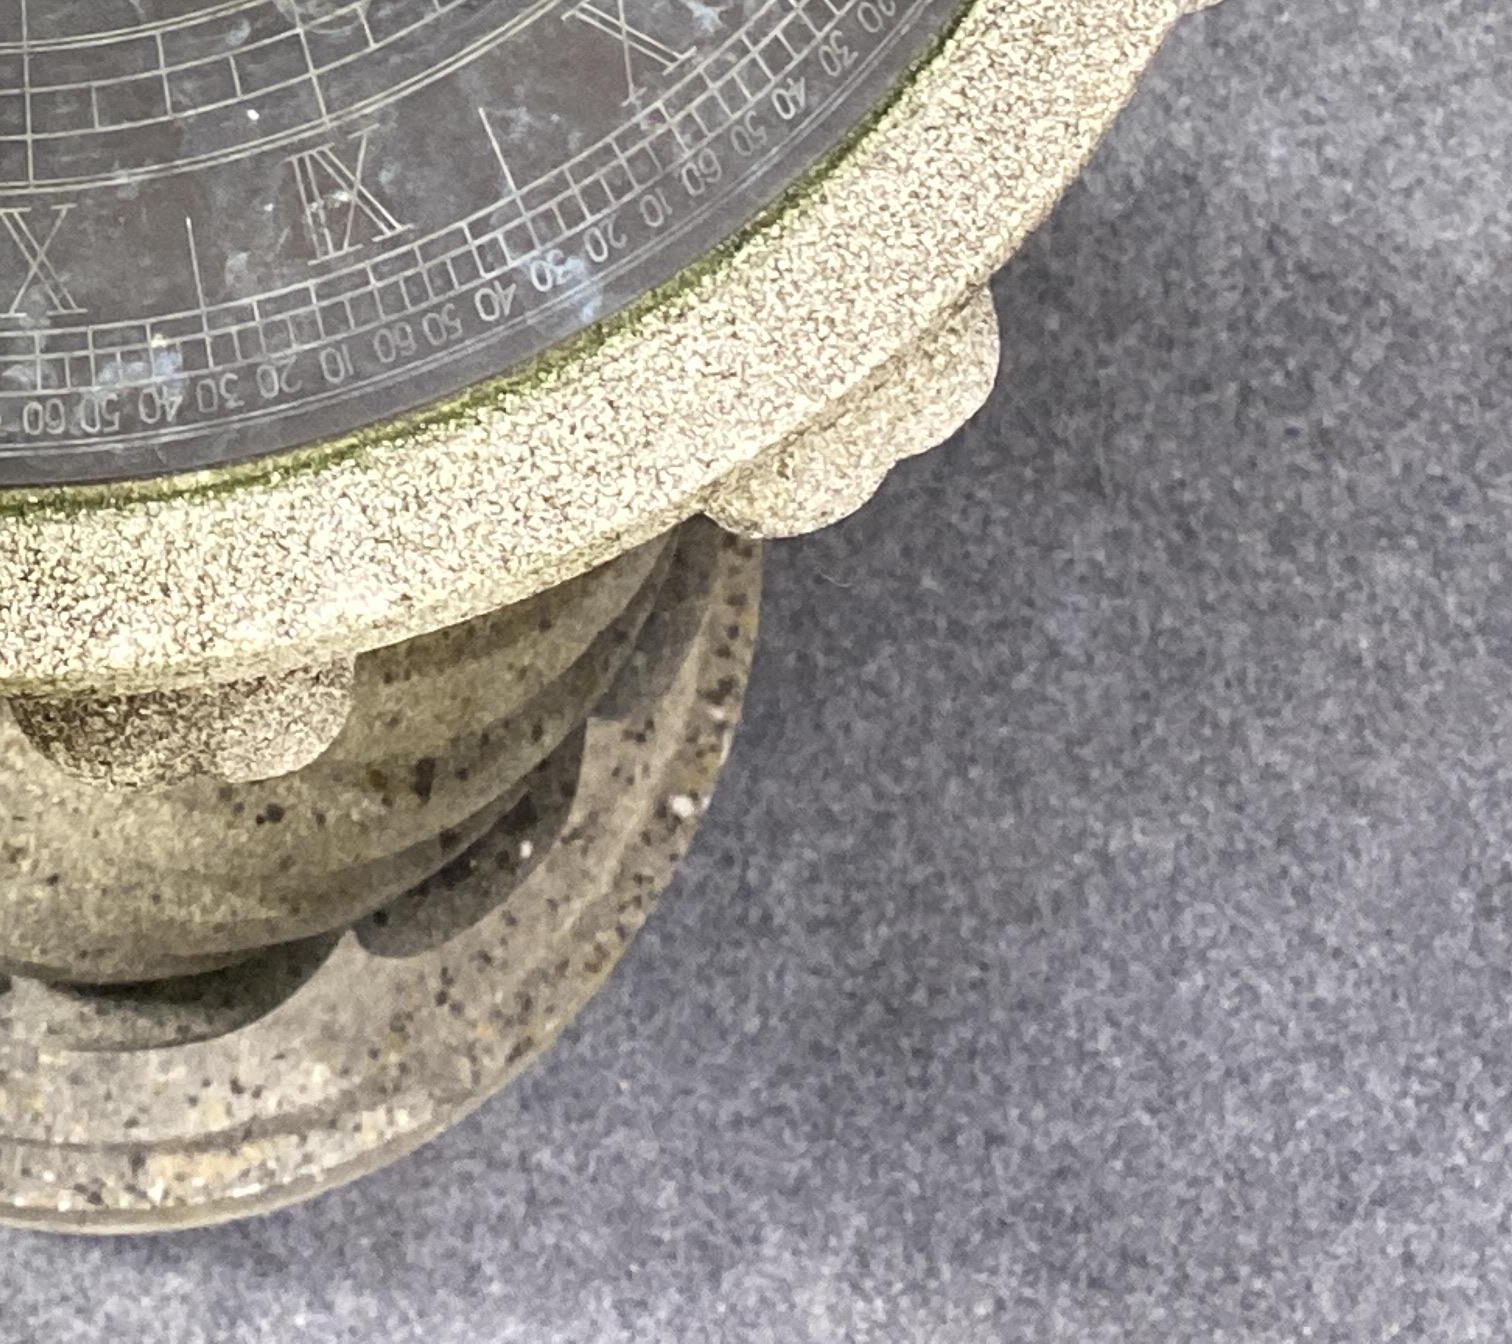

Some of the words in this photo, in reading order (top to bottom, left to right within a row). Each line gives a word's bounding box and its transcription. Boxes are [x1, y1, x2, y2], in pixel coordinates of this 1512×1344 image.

[815, 30, 854, 76] 30
[770, 72, 812, 119] 40
[728, 111, 768, 157] 50
[285, 124, 412, 264] XI
[679, 148, 723, 196] 60
[638, 189, 671, 227] 10
[584, 217, 625, 262] 20
[528, 247, 571, 292] 30
[474, 276, 519, 321] 40
[373, 321, 414, 363] 60
[422, 302, 461, 346] 50
[256, 356, 301, 398] 20
[320, 343, 351, 383] 10
[80, 393, 120, 433] 50
[138, 384, 183, 424] 40
[196, 373, 240, 412] 30
[23, 399, 65, 434] 60
